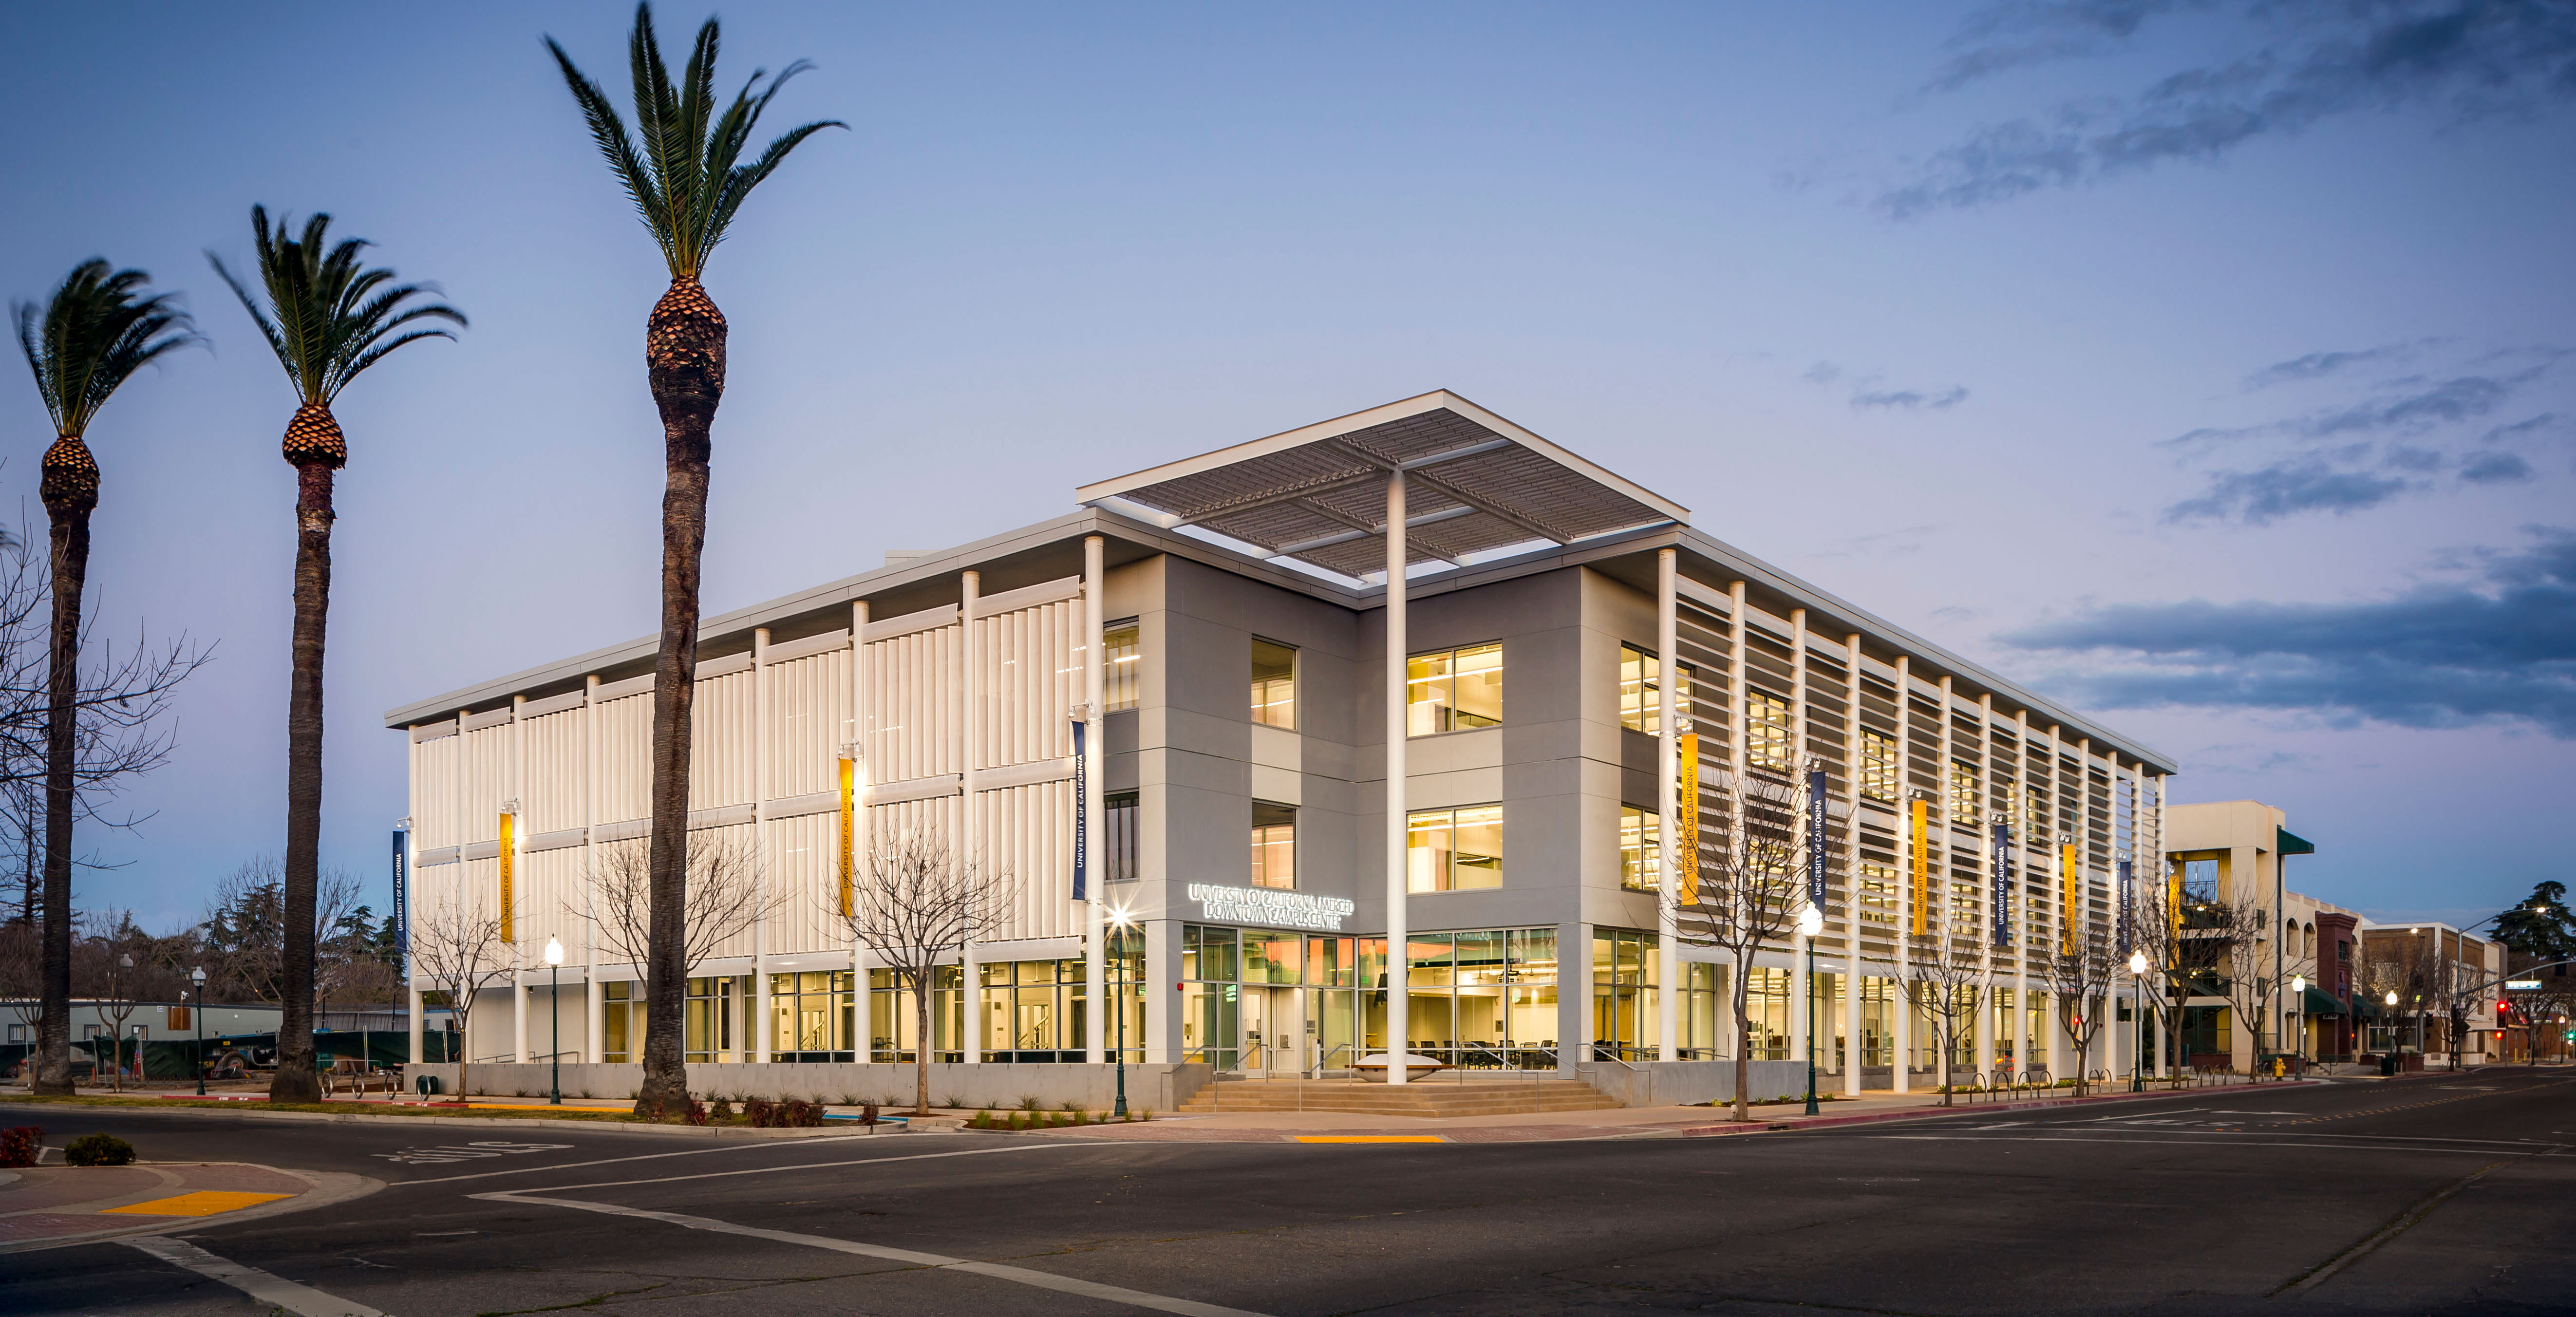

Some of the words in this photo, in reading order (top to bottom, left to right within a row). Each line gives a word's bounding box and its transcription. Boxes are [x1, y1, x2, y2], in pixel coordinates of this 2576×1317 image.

[1077, 806, 1084, 818] OF
[1687, 816, 1693, 827] OF
[844, 834, 849, 845] OF
[1815, 843, 1822, 853] OF
[1917, 865, 1923, 873] OF
[504, 875, 508, 883] OF
[1998, 883, 2004, 891] OF
[1191, 884, 1247, 903] UNIVERSITY
[1320, 897, 1354, 914] MERCED
[1206, 903, 1269, 922] DOWNTOWN
[1270, 908, 1309, 924] CAMPUS
[1310, 912, 1341, 928] CENTER
